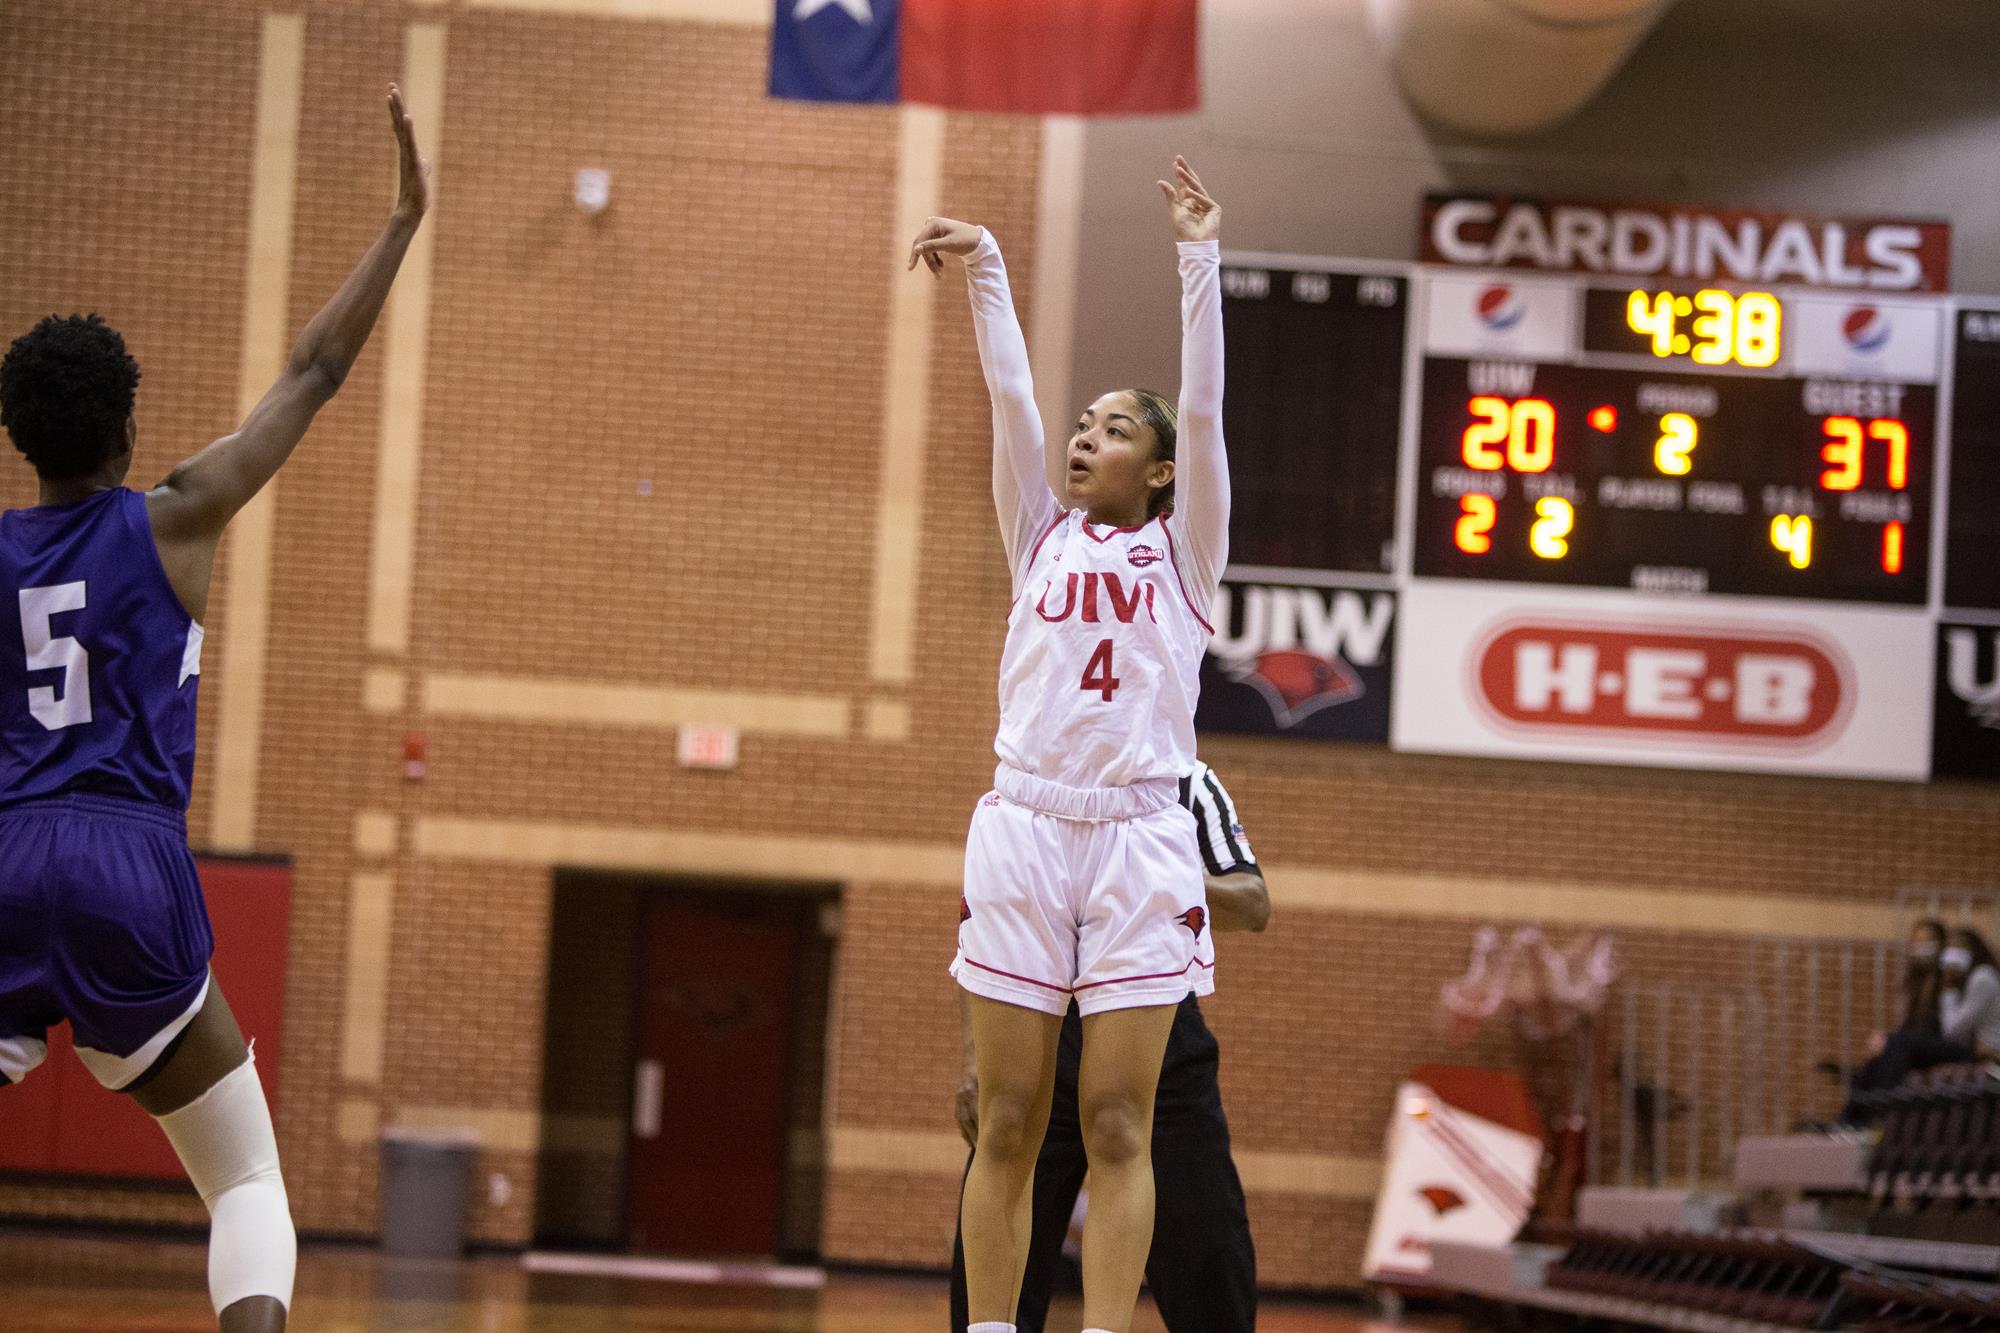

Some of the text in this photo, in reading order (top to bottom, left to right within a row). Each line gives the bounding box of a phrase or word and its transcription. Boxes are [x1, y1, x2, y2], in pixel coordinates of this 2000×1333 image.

[1432, 200, 1923, 289] CARDINALS
[1626, 288, 1781, 367] 4:38
[1461, 395, 1556, 473] 20
[1654, 412, 1697, 475] 2
[1819, 415, 1908, 491] 37
[1454, 492, 1496, 554] 2
[1530, 496, 1574, 559] 2
[1770, 513, 1812, 569] 4
[1881, 519, 1904, 575] 1
[19, 580, 92, 731] 5
[1205, 583, 1394, 667] UIW
[1080, 639, 1120, 702] 4
